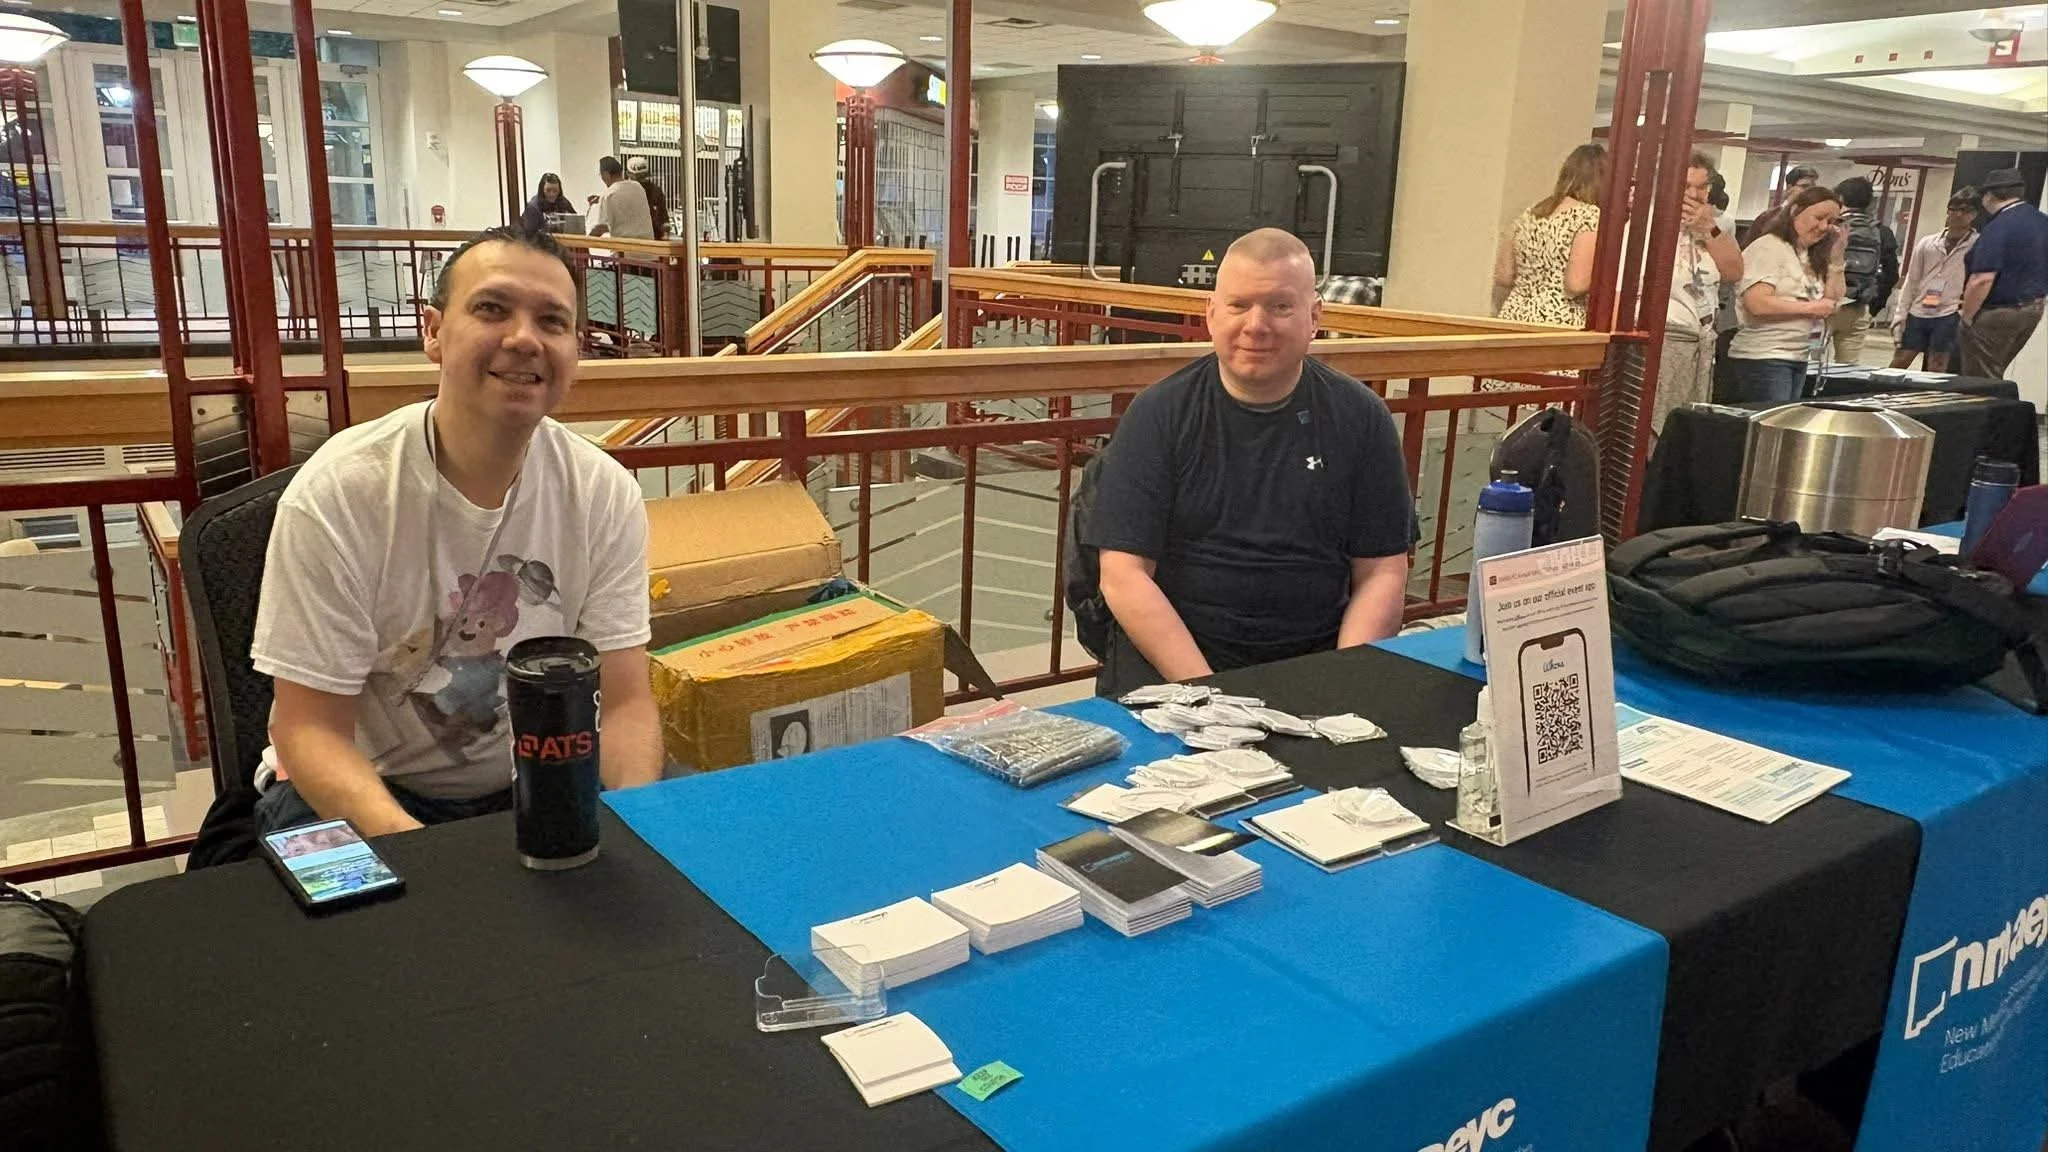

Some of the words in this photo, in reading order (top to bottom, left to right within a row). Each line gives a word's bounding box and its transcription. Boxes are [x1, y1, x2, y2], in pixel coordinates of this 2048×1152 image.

[1866, 165, 1911, 187] Don's
[1944, 1026, 1977, 1047] New
[1417, 1098, 1516, 1152] eyc
